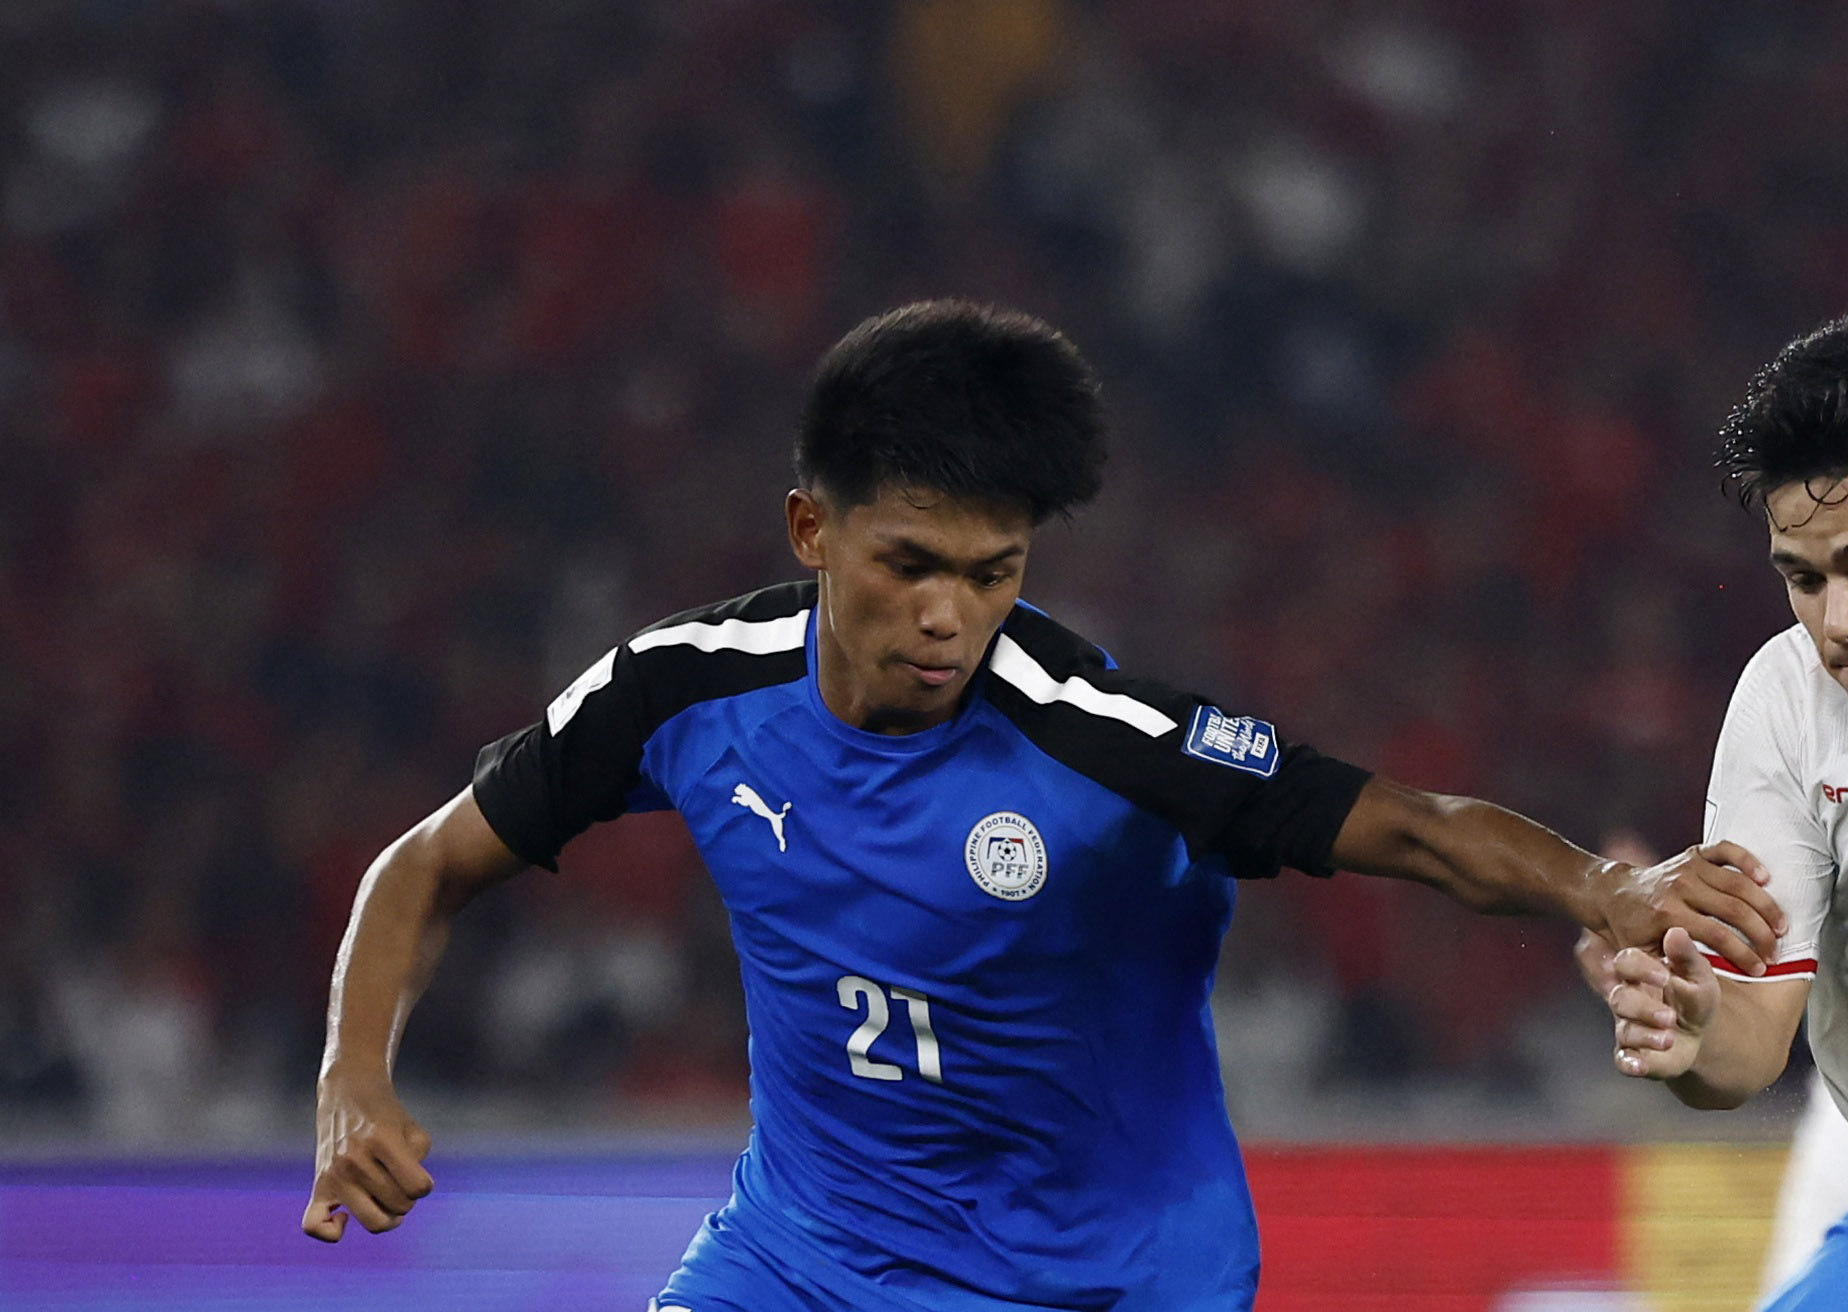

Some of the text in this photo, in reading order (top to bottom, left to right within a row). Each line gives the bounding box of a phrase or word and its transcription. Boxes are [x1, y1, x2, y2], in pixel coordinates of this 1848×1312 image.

[1201, 713, 1222, 747] FOOTB
[1213, 718, 1241, 753] UNITE
[969, 816, 1044, 891] PHILIPPINE FOOTBALL FEDERATION
[990, 861, 1029, 879] PFF
[836, 975, 943, 1083] 21
